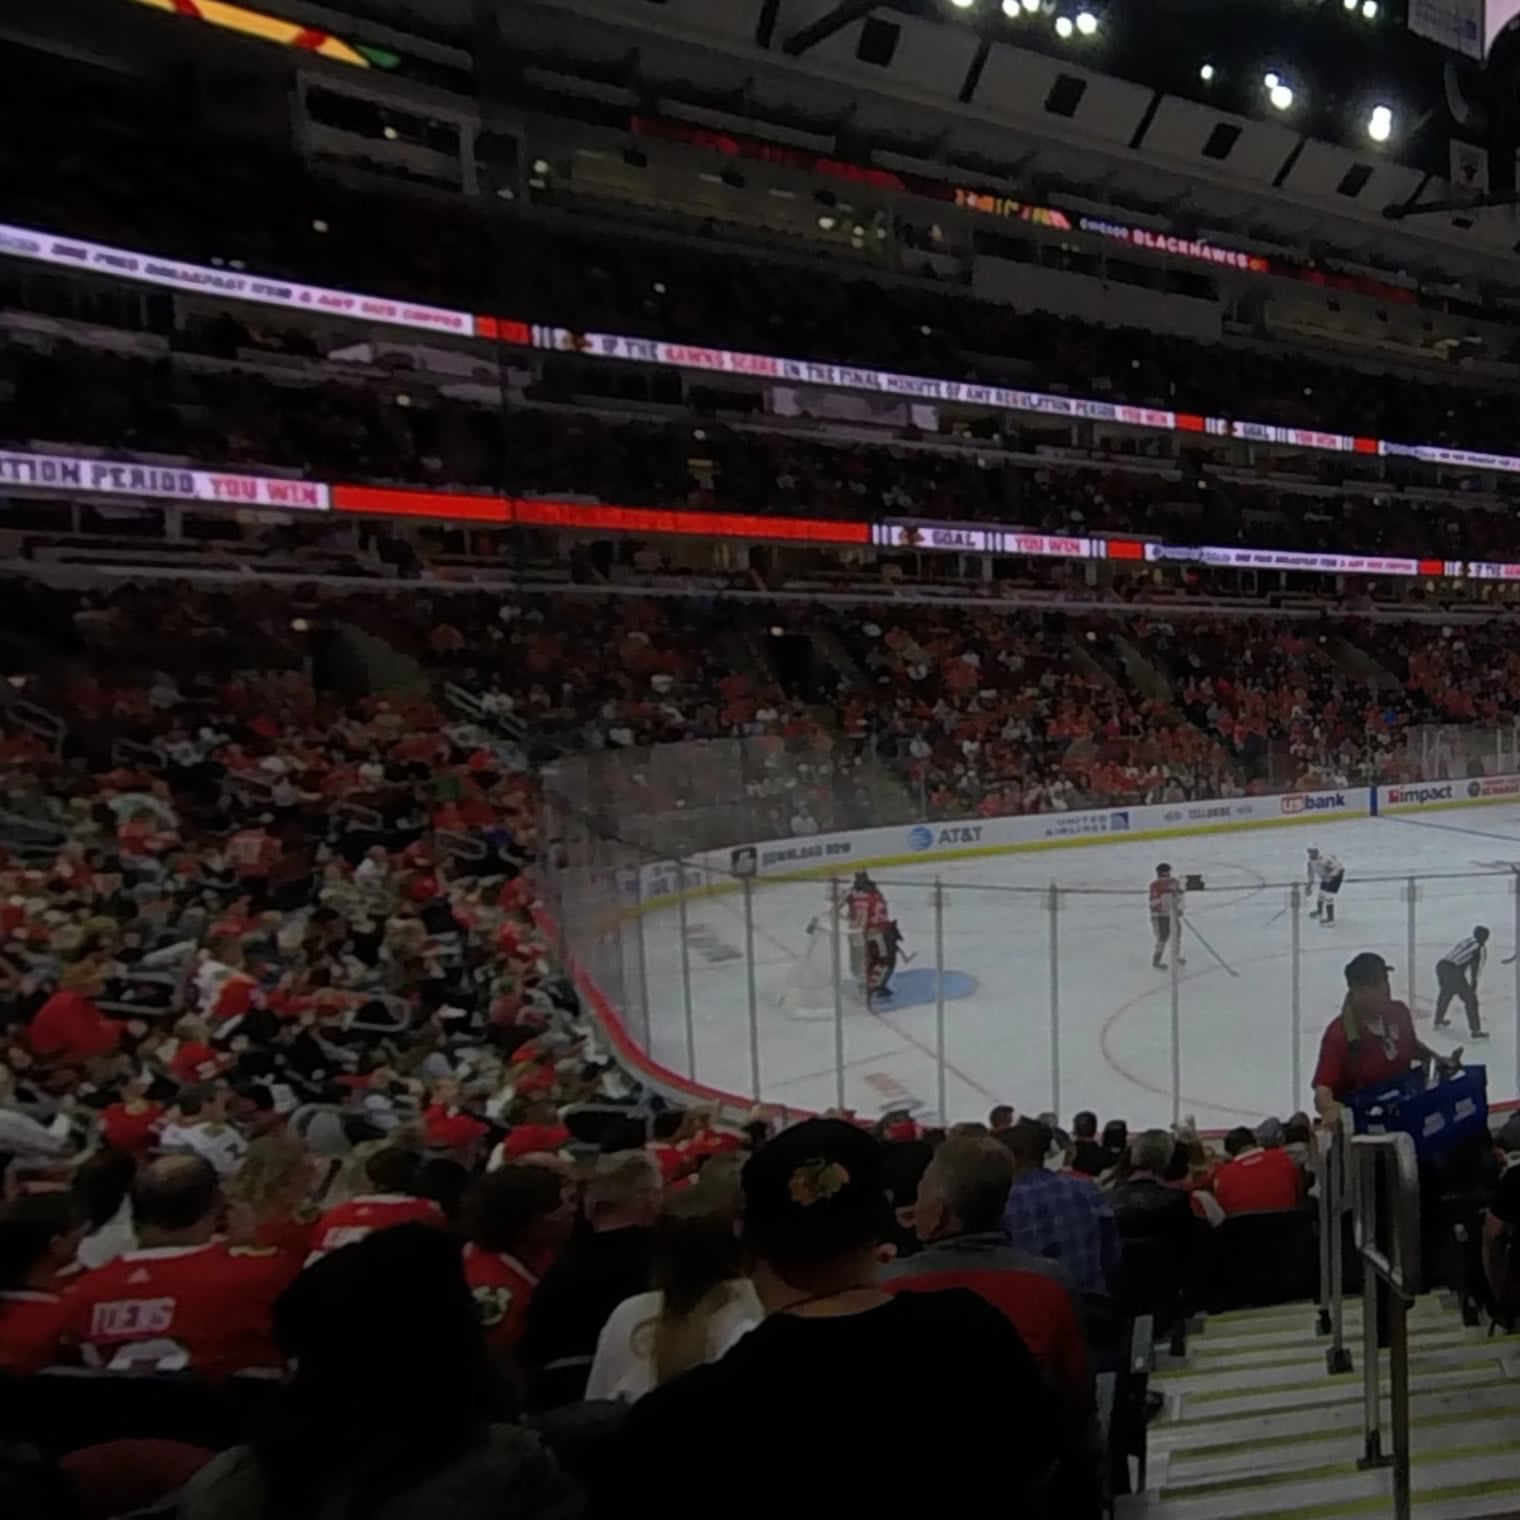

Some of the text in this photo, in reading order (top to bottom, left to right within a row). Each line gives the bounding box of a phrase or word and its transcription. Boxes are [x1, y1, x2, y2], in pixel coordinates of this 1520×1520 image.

[1132, 229, 1251, 269] BLACKHAWKS
[91, 464, 201, 499] PERIOD,
[209, 475, 258, 500] YOU
[266, 480, 319, 506] WIN
[931, 531, 1082, 554] GOAL YOU WIN
[1400, 784, 1453, 804] impact
[938, 826, 984, 845] AT&T
